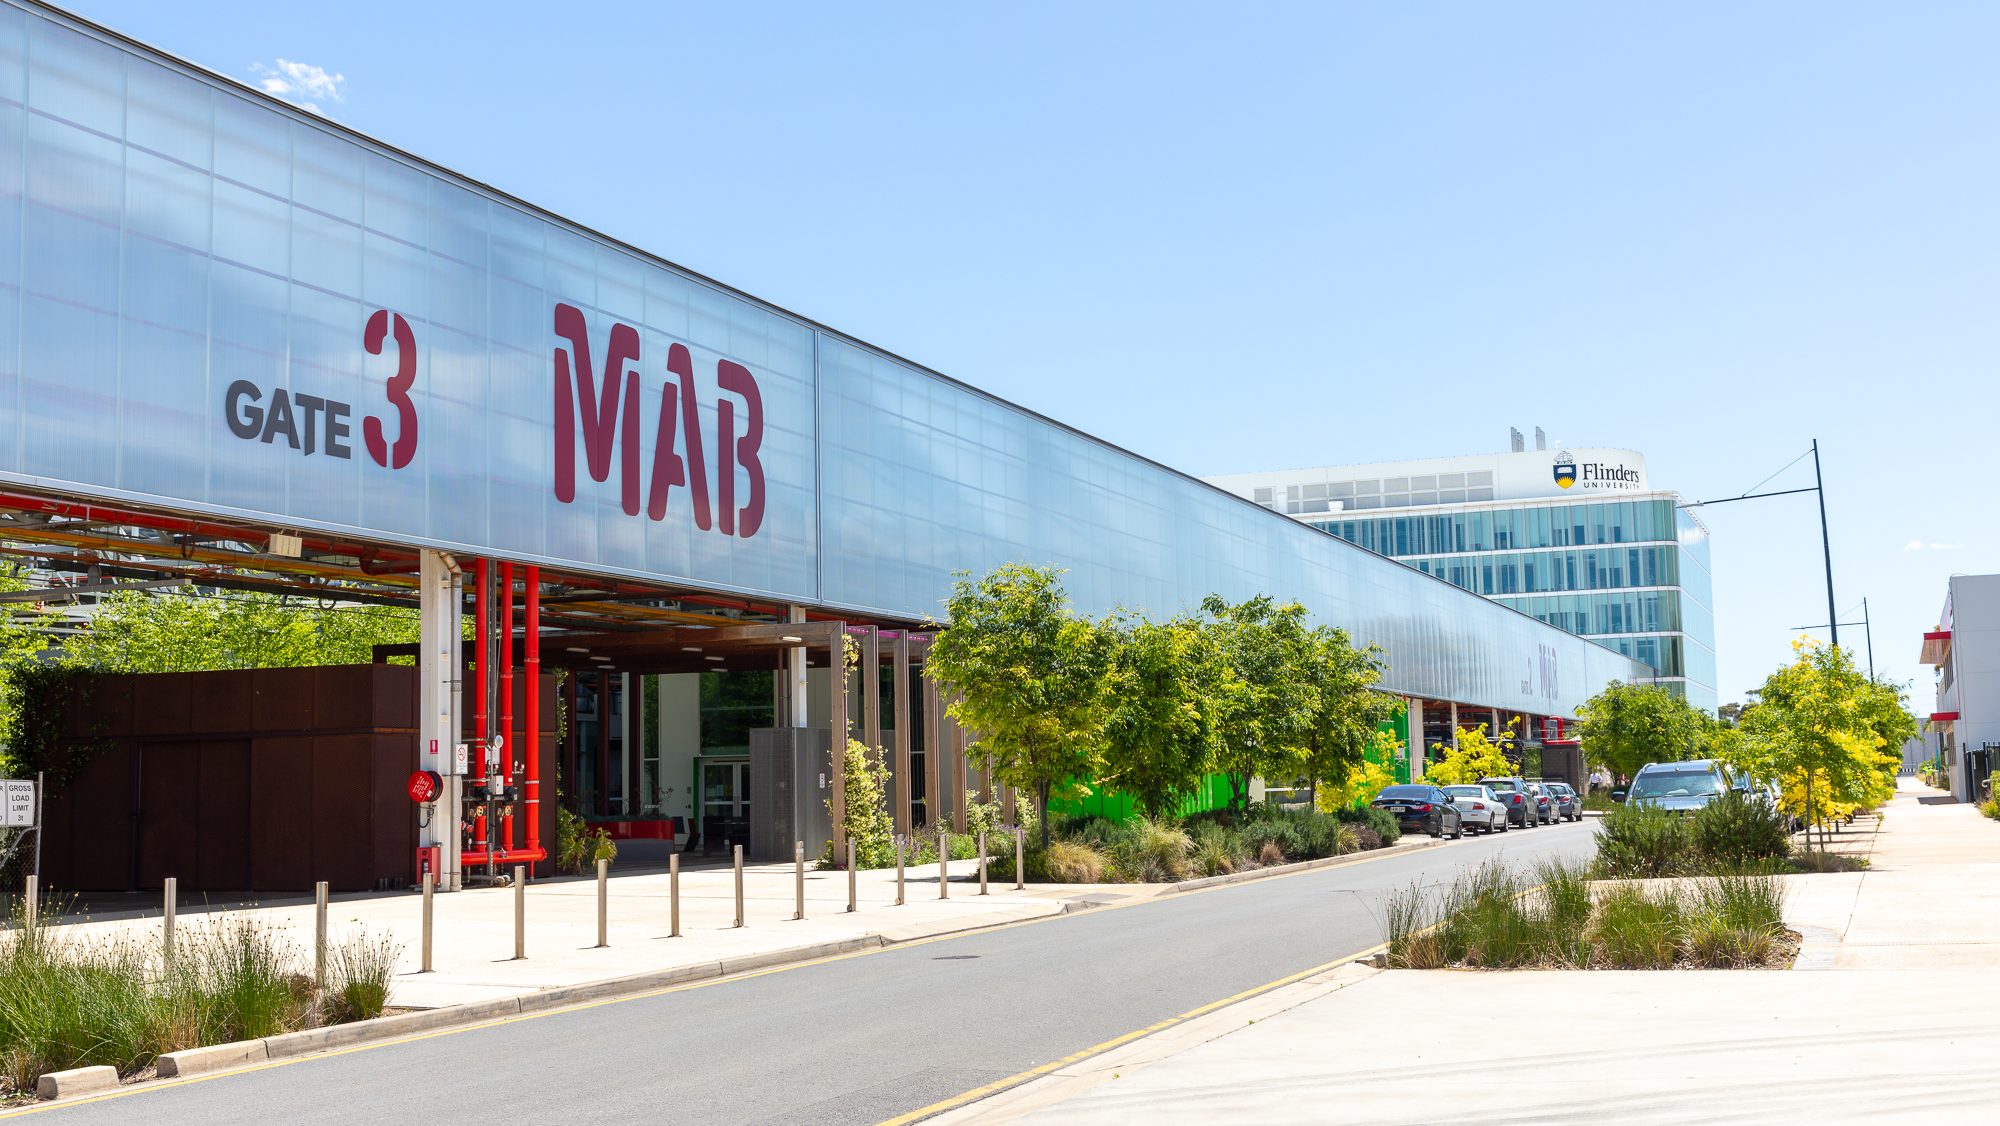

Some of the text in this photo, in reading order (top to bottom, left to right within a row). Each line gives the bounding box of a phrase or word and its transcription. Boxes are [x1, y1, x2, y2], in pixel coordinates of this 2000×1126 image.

[225, 309, 418, 470] GATE 3
[554, 302, 766, 539] MAB
[1582, 463, 1639, 482] Flinders
[1583, 482, 1640, 490] UNIVERSITY
